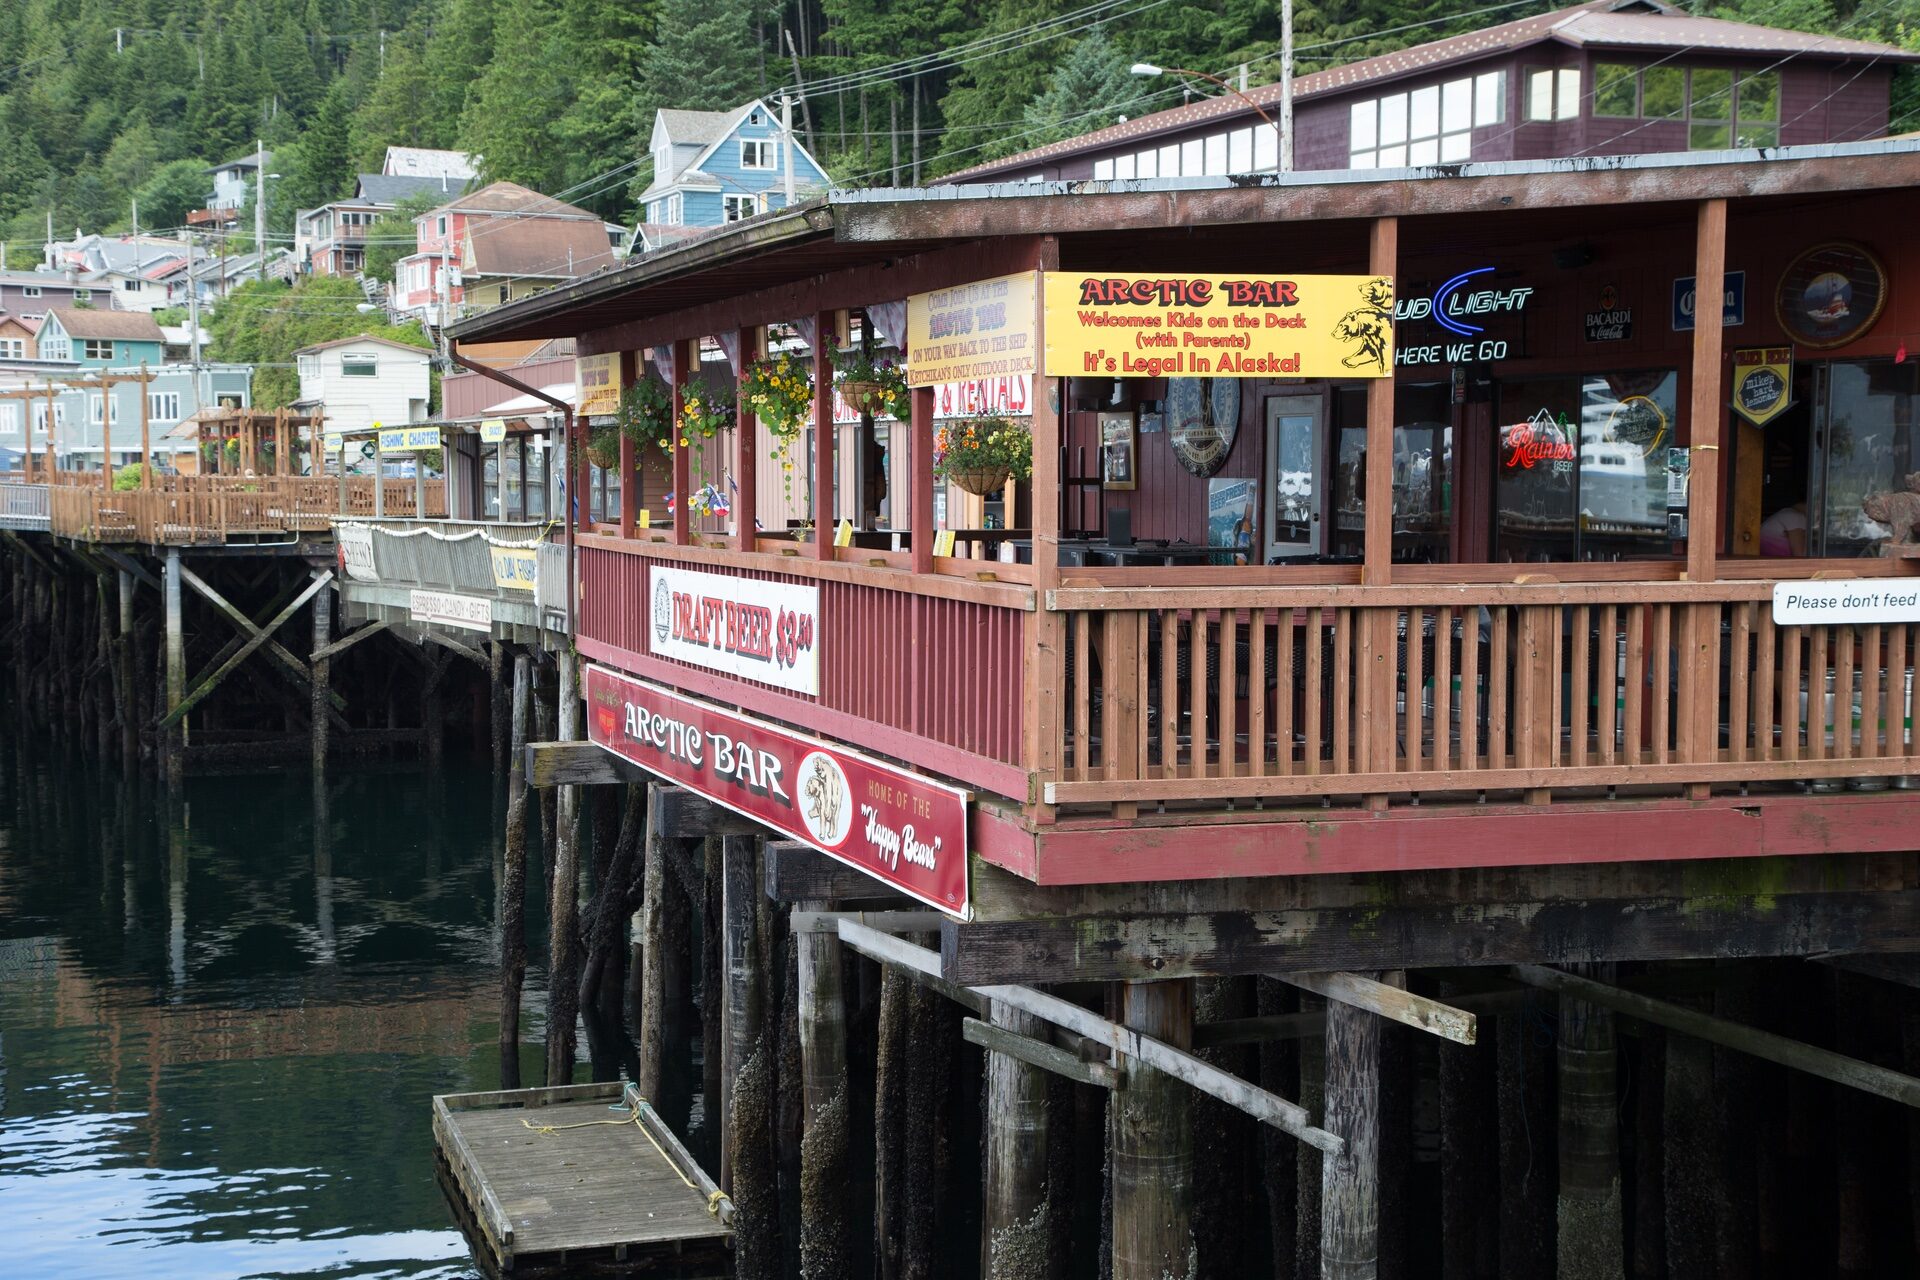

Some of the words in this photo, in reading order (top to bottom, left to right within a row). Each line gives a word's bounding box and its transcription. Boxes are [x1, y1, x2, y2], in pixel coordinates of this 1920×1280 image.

[981, 283, 991, 300] AT
[1078, 278, 1214, 307] ARCTIC
[1219, 280, 1300, 307] BAR
[1394, 298, 1432, 320] UD
[1448, 287, 1534, 315] LIGHT
[929, 307, 974, 340] ARCTIC
[976, 302, 1007, 331] BAR
[1077, 310, 1162, 328] Welcomes
[1167, 311, 1203, 328] Kids
[1207, 315, 1229, 328] on
[1233, 312, 1260, 328] the
[1265, 312, 1307, 328] Deck
[912, 348, 923, 364] ON
[923, 345, 942, 362] YOUR
[943, 343, 958, 359] WAY
[959, 339, 978, 357] BACK
[979, 338, 989, 354] TO
[991, 335, 1007, 353] THE
[1009, 332, 1028, 350] SHIP
[1136, 331, 1178, 349] (with
[1183, 331, 1251, 350] Parents)
[1394, 345, 1441, 366] HERE
[1446, 343, 1474, 362] WE
[1478, 340, 1508, 361] GO
[952, 363, 971, 379] ONLY
[972, 359, 1008, 377] OUTDOOR
[1009, 356, 1033, 372] DECK
[1083, 350, 1117, 372] It's
[1122, 351, 1184, 377] Legal
[1189, 352, 1211, 372] In
[1216, 352, 1301, 373] Alaska!
[1746, 375, 1775, 389] mike's
[1753, 384, 1774, 398] hard
[1745, 391, 1780, 408] lemonade
[381, 433, 404, 448] FISHING
[409, 431, 439, 446] CHARTER
[1506, 422, 1575, 468] Rainier
[1553, 461, 1573, 472] BEER
[503, 556, 517, 580] DAY
[412, 594, 441, 613] ESPRESSO
[445, 598, 466, 617] CANDY
[469, 602, 490, 621] GIFTS
[1786, 595, 1838, 609] Please
[1842, 594, 1880, 608] don't
[1883, 593, 1918, 607] feed
[672, 591, 724, 651] DRAFT
[725, 600, 774, 664] BEER
[624, 701, 704, 770] ARCTIC
[705, 730, 793, 809] BAR
[868, 779, 893, 805] HOME
[896, 790, 908, 811] OF
[912, 796, 931, 820] THE
